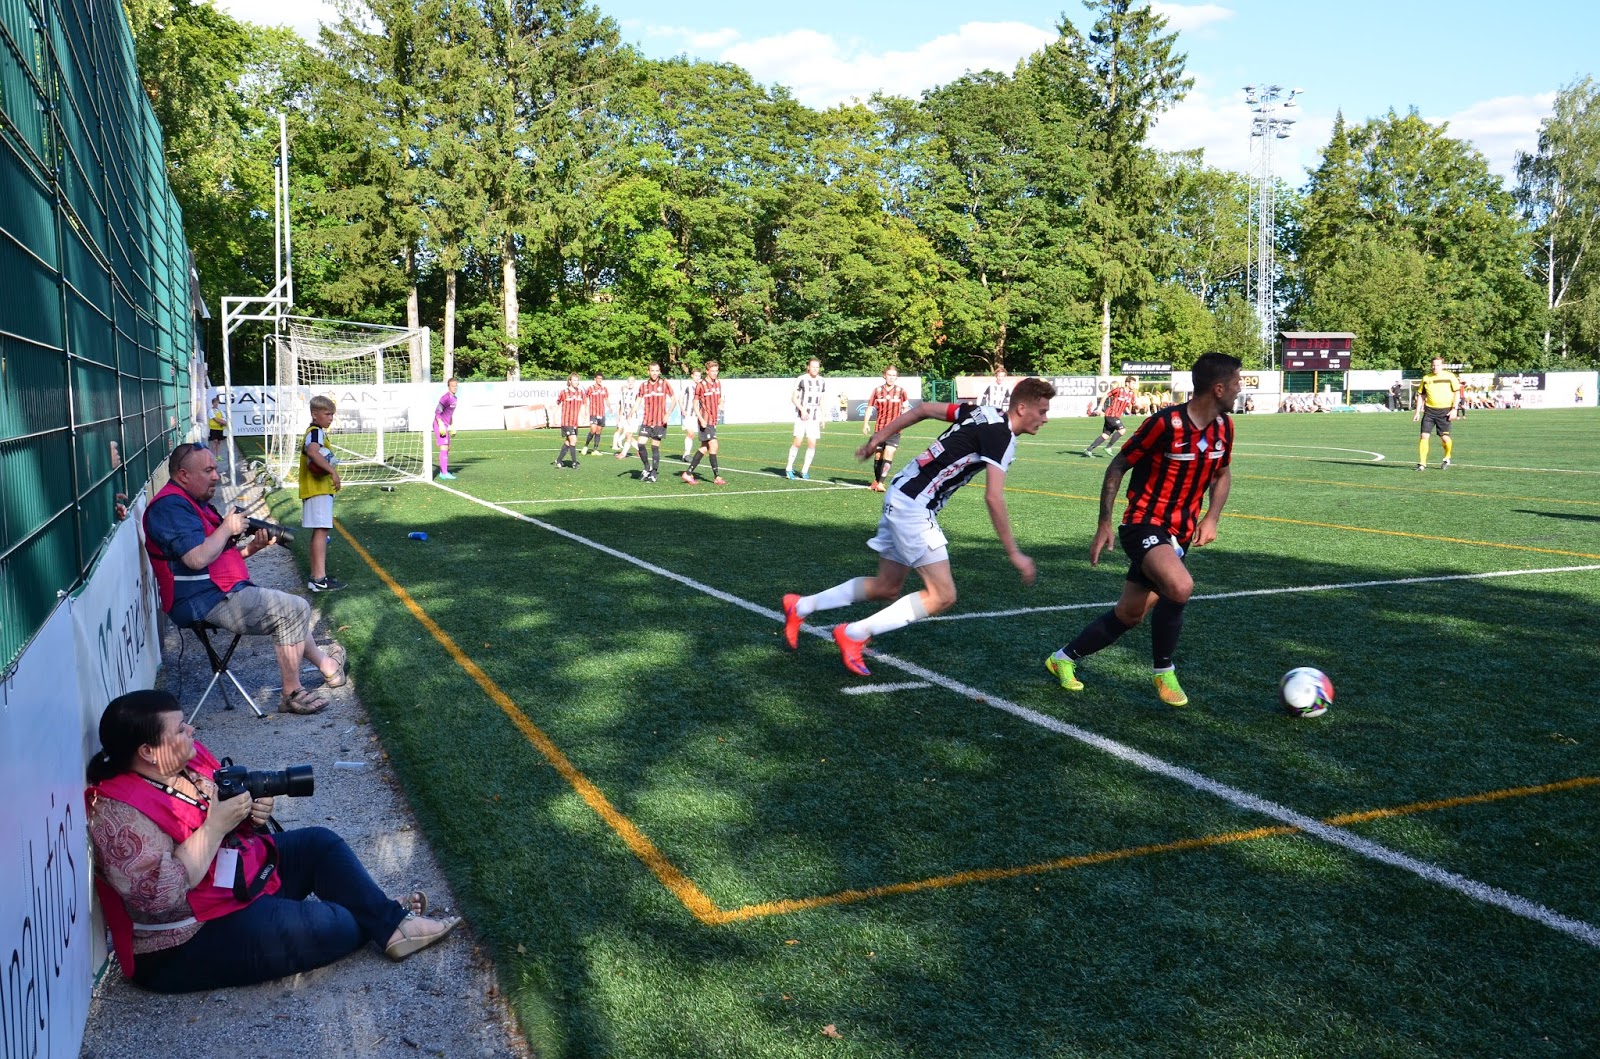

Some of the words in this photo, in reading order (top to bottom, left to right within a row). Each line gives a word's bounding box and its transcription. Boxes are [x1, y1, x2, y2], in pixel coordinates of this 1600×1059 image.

[1055, 378, 1095, 386] MASTER
[1057, 387, 1093, 395] PROMO
[1142, 535, 1160, 549] 38
[0, 792, 77, 1059] nalytics
